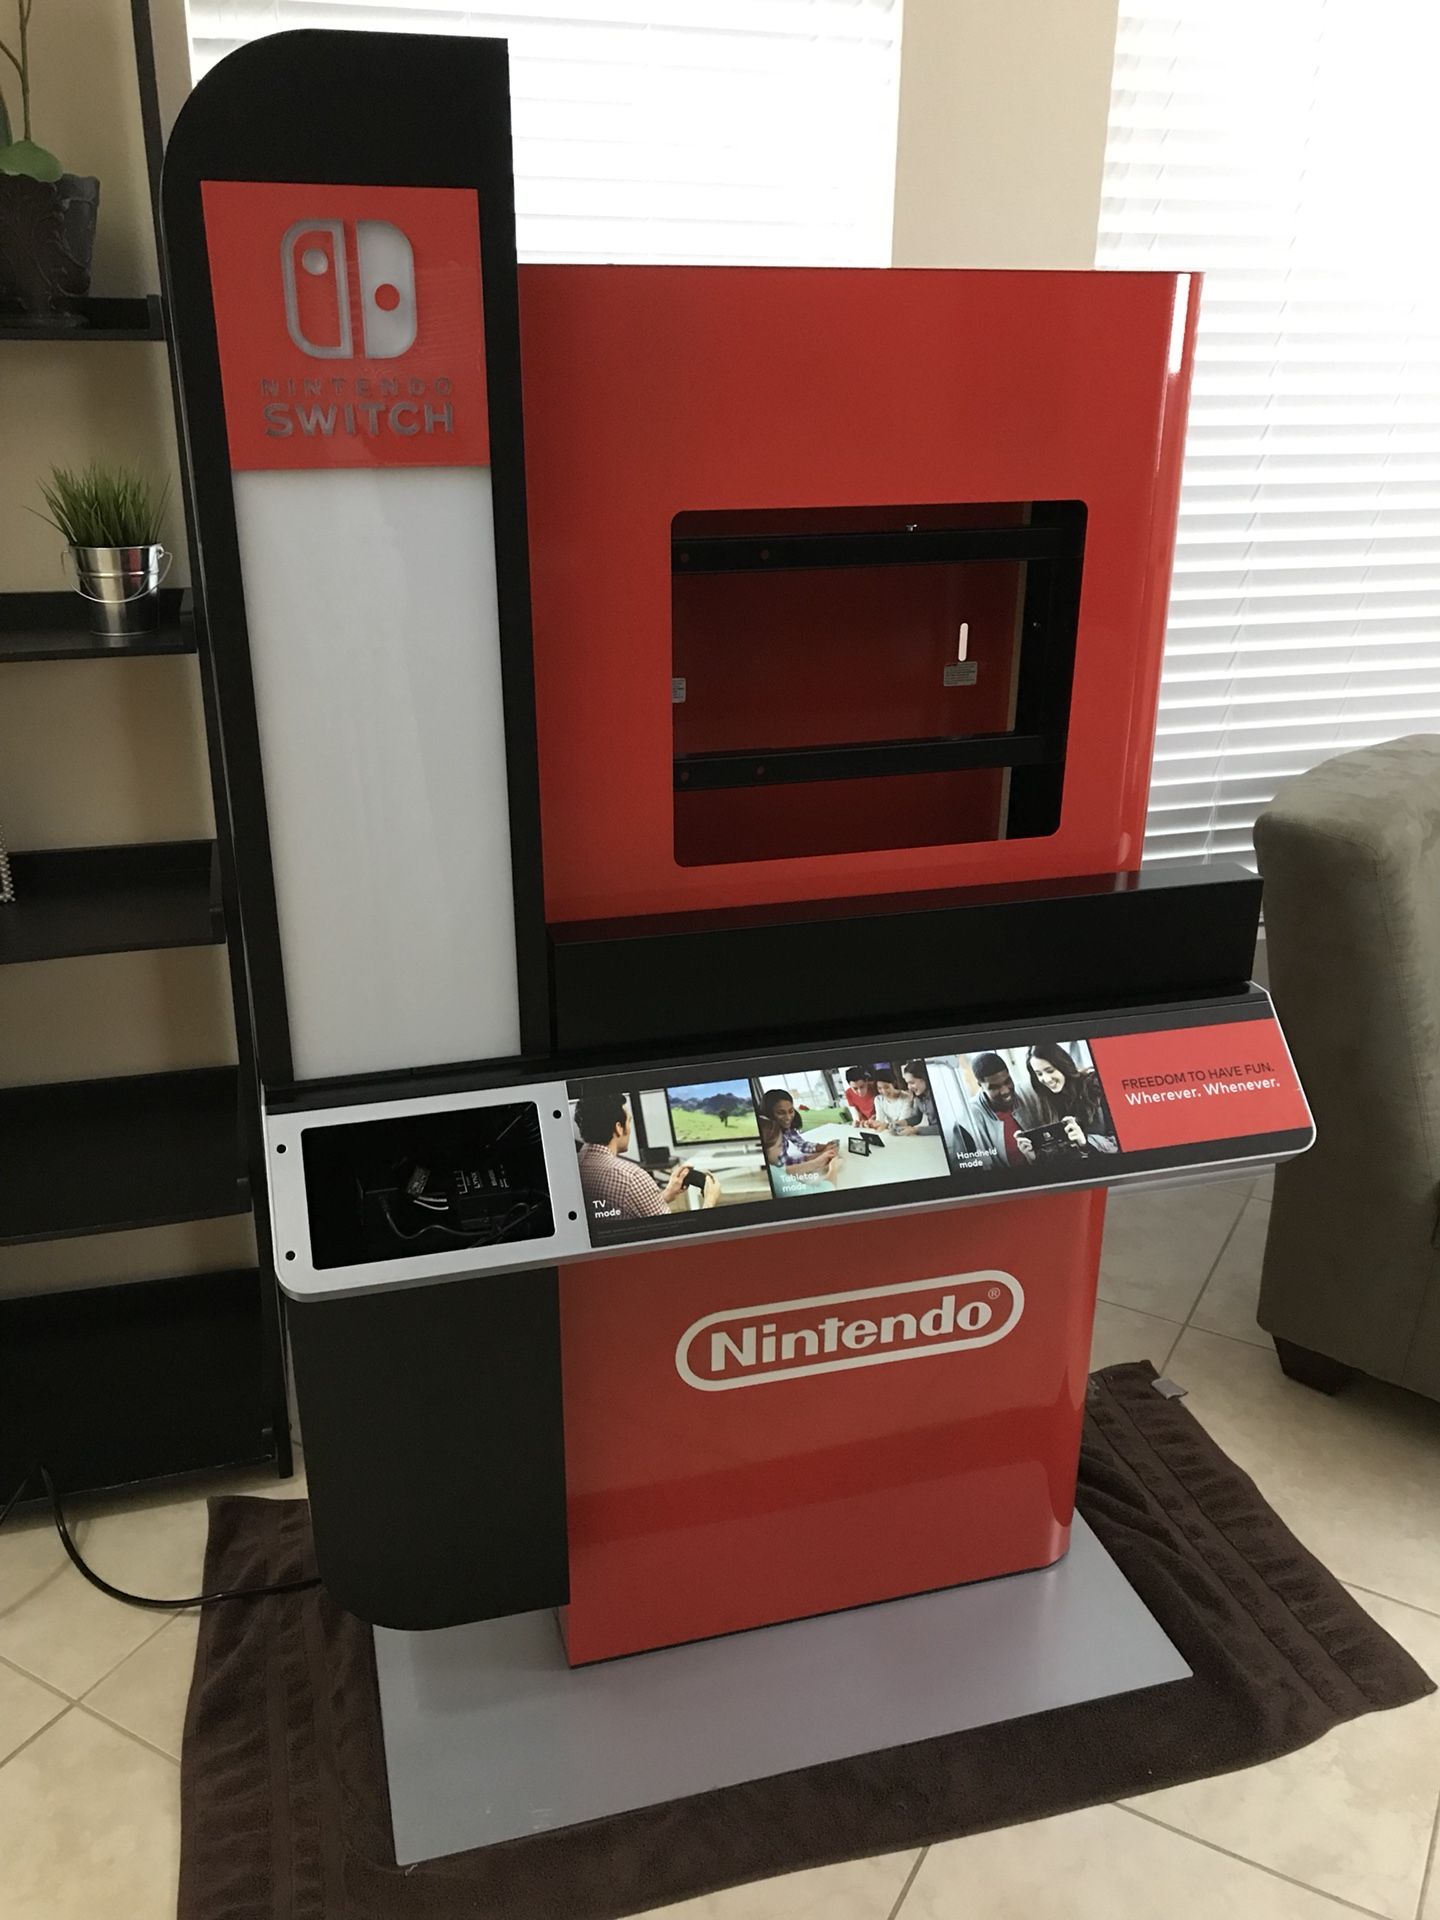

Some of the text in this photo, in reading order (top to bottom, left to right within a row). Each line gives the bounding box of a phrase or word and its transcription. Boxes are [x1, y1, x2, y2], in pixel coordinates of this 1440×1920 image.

[260, 376, 453, 397] NINTENDO
[263, 402, 455, 438] SWITCH
[1121, 1062, 1275, 1090] FREEDOM TO HAVE FUN.
[1125, 1077, 1281, 1106] Wherever. Whenever.
[956, 1147, 998, 1160] Handheld
[959, 1159, 984, 1169] mode
[780, 1171, 820, 1183] Tabletop
[593, 1199, 607, 1209] TV
[594, 1208, 622, 1219] mode
[711, 1294, 993, 1373] Nintendo
